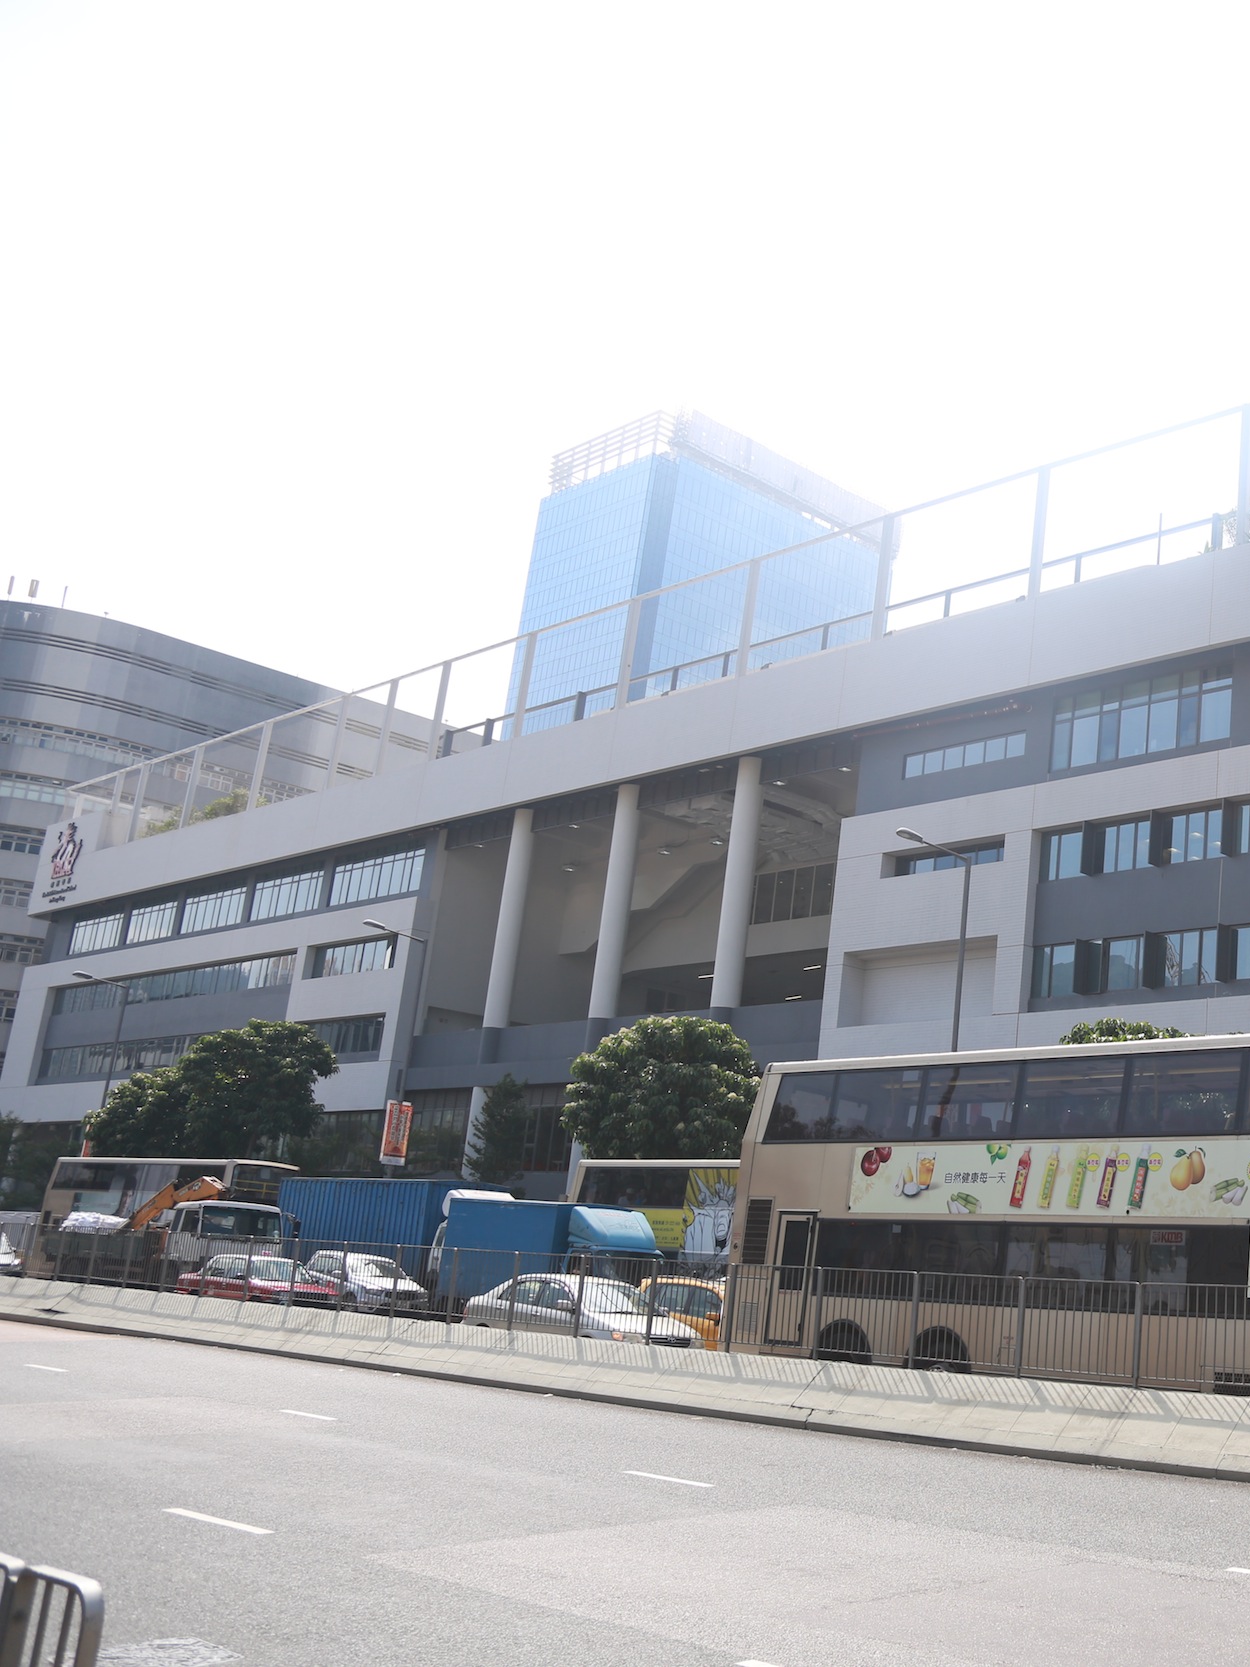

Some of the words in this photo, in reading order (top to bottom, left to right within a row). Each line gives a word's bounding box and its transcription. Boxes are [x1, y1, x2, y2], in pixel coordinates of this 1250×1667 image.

[944, 1171, 1006, 1184] 自然健康每一天
